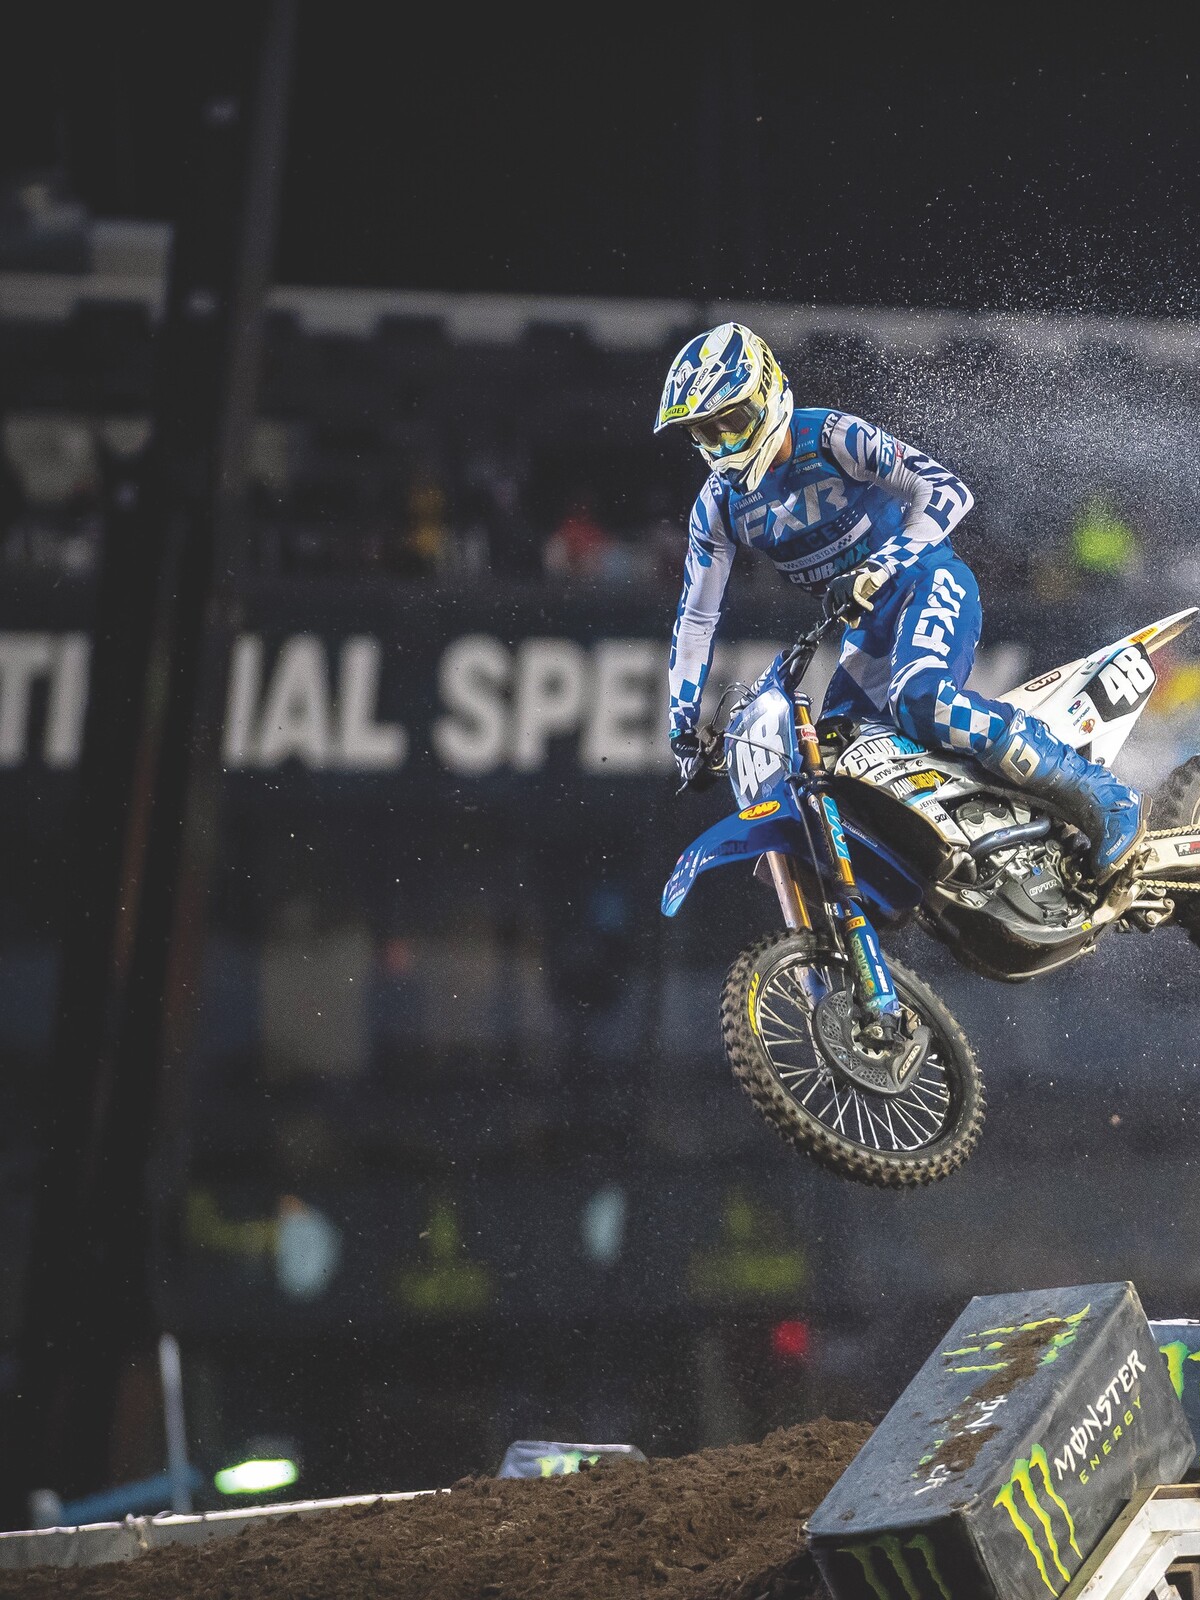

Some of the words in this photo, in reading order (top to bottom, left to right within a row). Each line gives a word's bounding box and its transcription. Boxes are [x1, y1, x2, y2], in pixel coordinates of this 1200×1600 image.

[733, 491, 763, 510] YAMAHA
[735, 477, 849, 546] FXR
[789, 537, 872, 585] CLUBMX
[1098, 646, 1157, 706] 48
[1053, 1349, 1147, 1481] MONSTER
[1079, 1395, 1141, 1485] ENERGY
